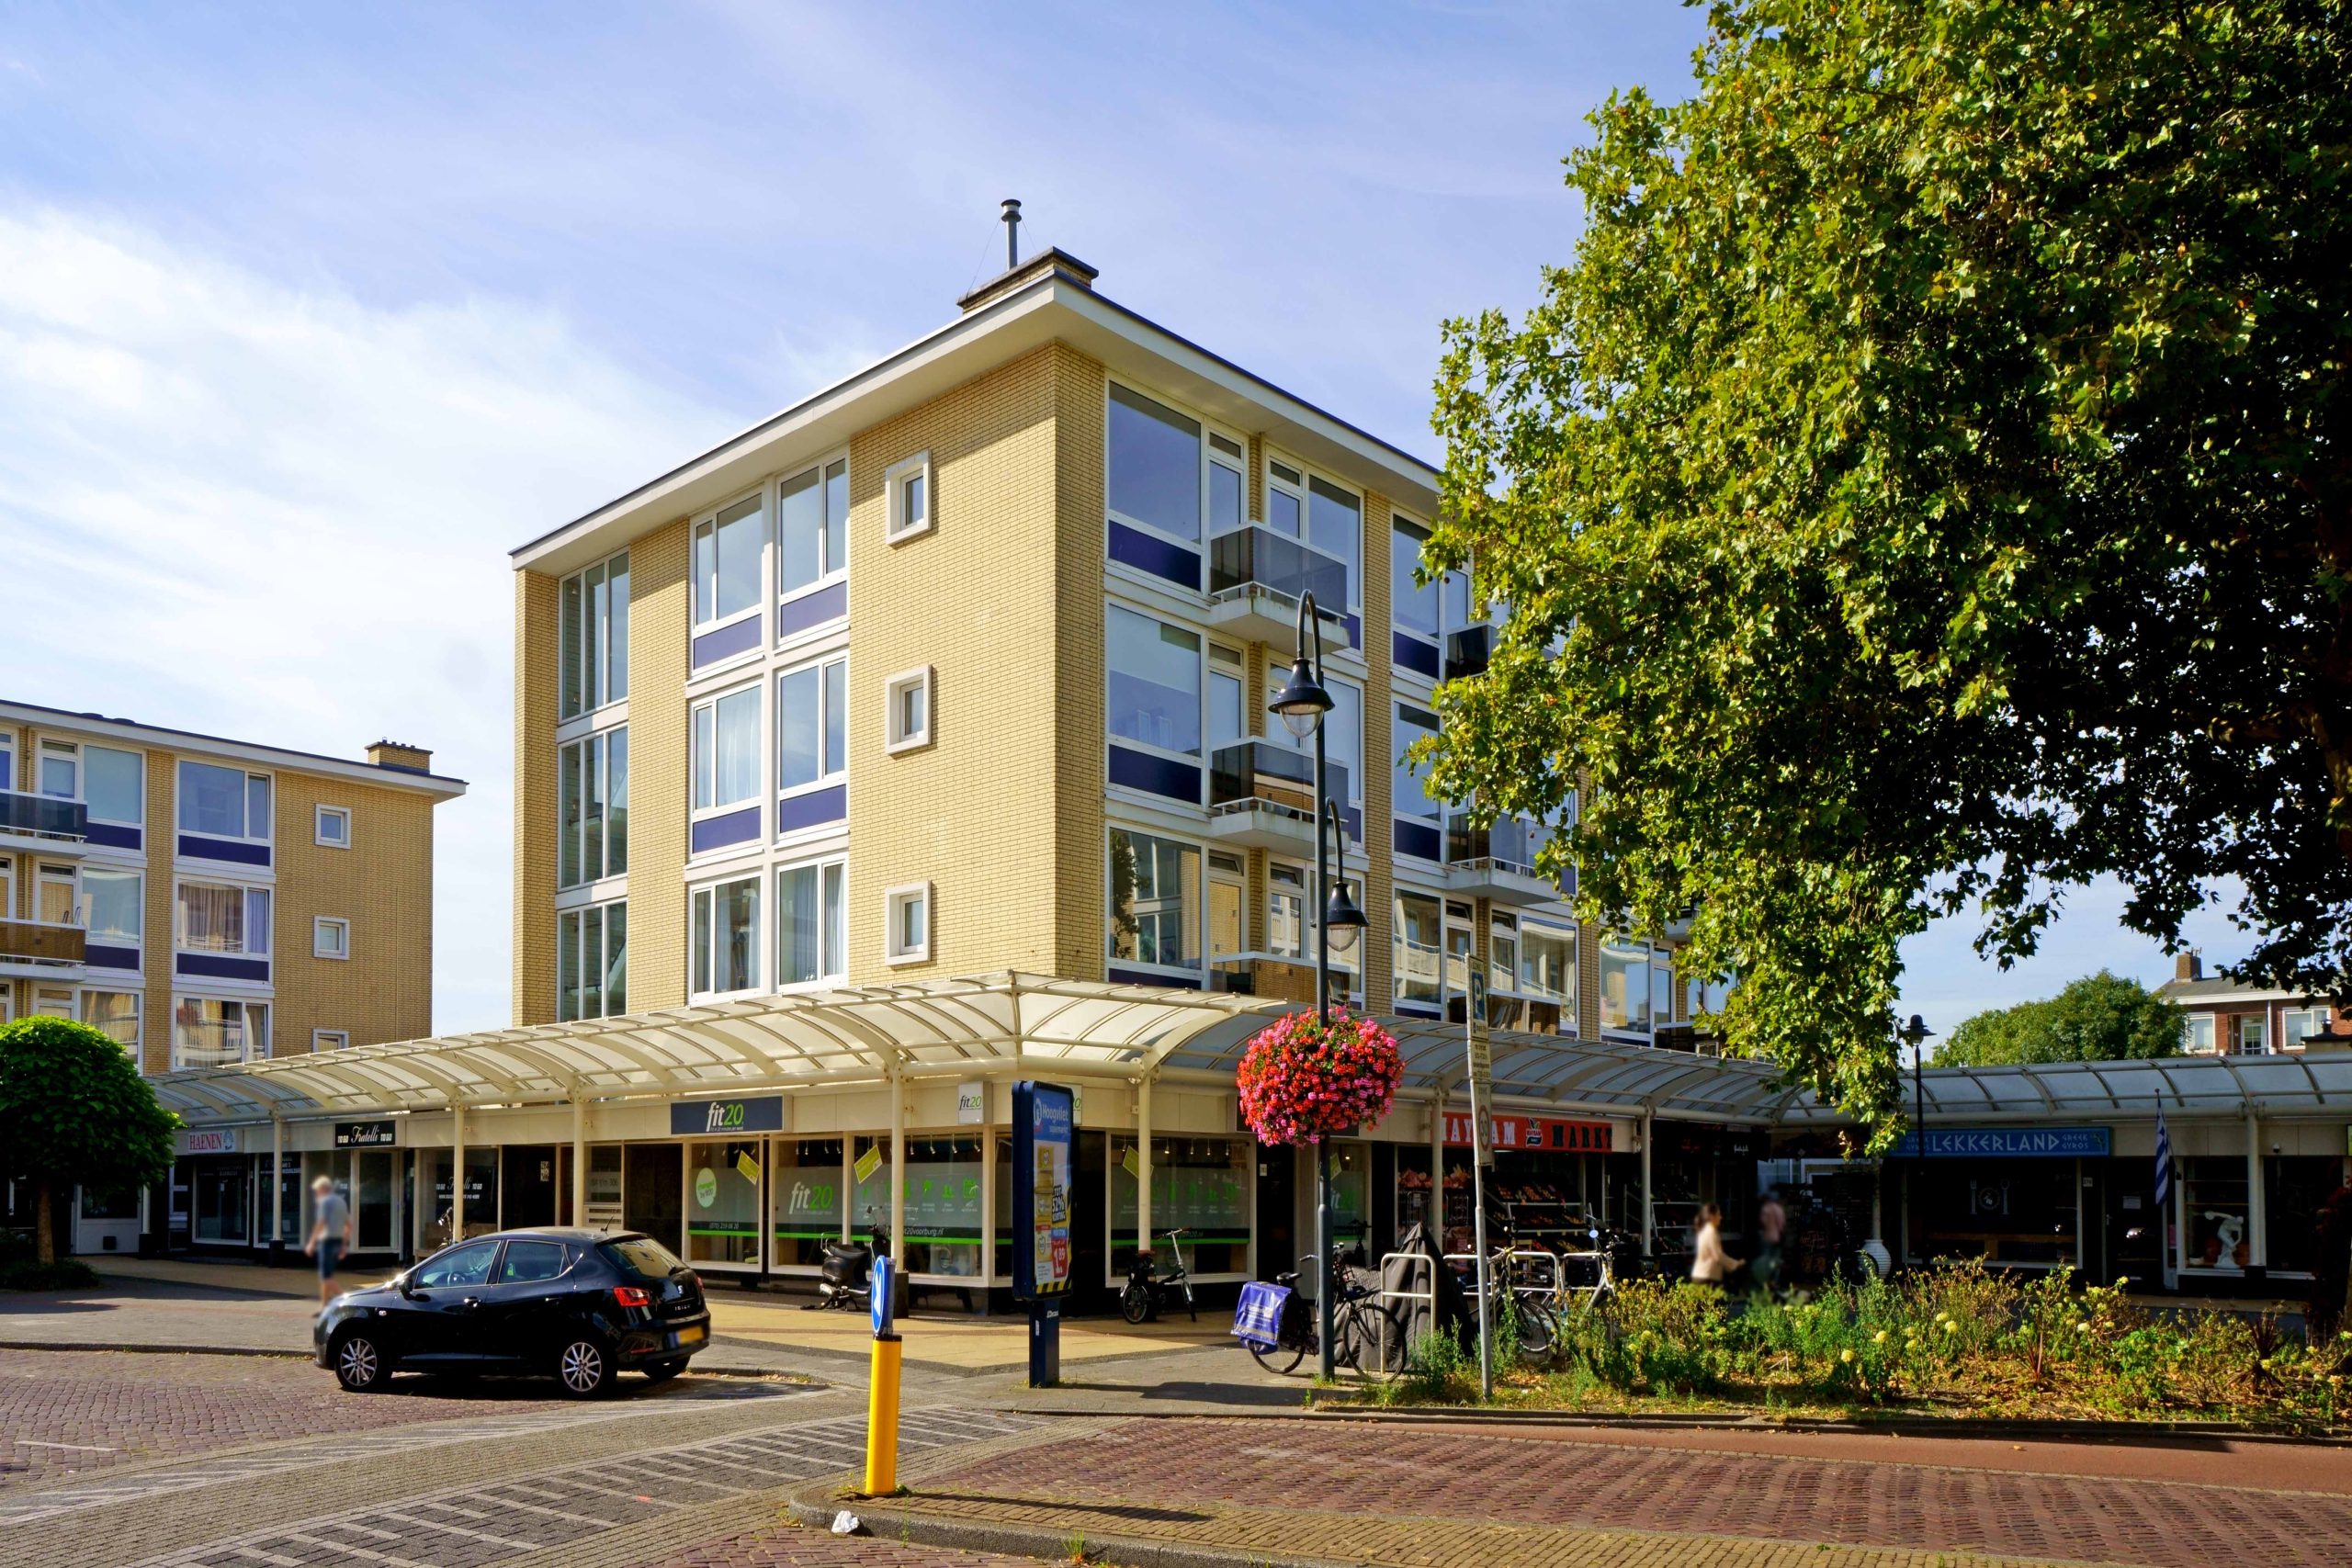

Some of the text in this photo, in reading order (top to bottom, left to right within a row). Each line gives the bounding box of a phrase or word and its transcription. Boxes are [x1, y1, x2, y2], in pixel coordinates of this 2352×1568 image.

[959, 1094, 982, 1111] fit20
[706, 1101, 744, 1132] fit20
[1042, 1103, 1069, 1124] Hoogvliet
[189, 1133, 222, 1150] HAENEN
[351, 1124, 379, 1144] Fratelli
[1932, 1134, 2059, 1152] LEKKERLAND
[788, 1181, 834, 1214] fit20
